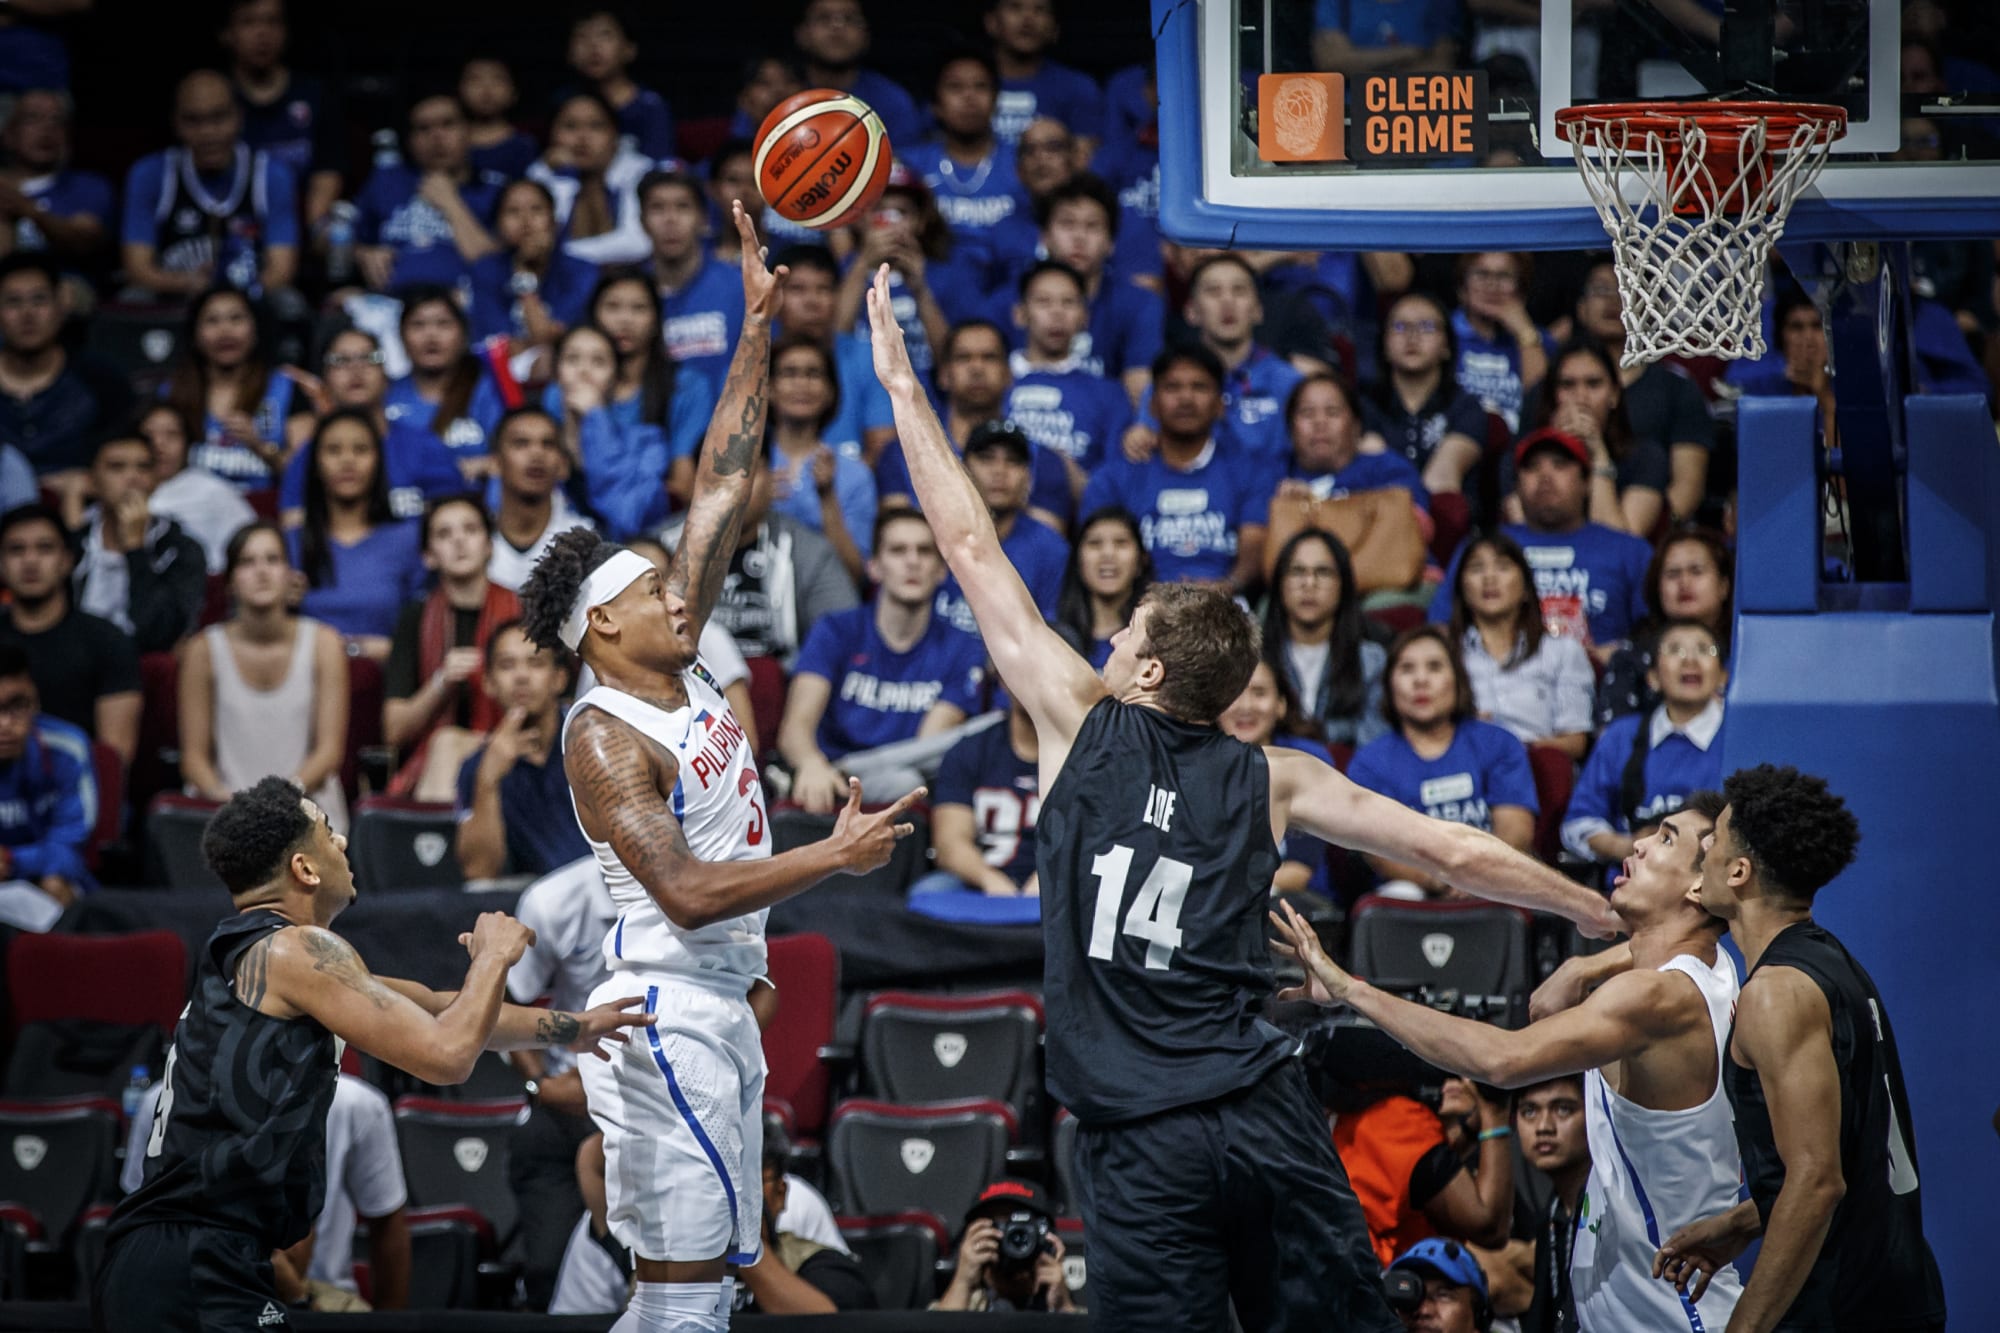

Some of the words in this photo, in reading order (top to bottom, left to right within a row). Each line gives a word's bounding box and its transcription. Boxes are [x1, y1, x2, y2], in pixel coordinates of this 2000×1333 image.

[1365, 75, 1473, 112] CLEAN
[1365, 114, 1473, 154] GAME
[791, 151, 853, 212] molten
[738, 767, 764, 846] 3
[1143, 783, 1176, 833] LOE
[1088, 844, 1194, 971] 14
[257, 1312, 285, 1327] PEAK
